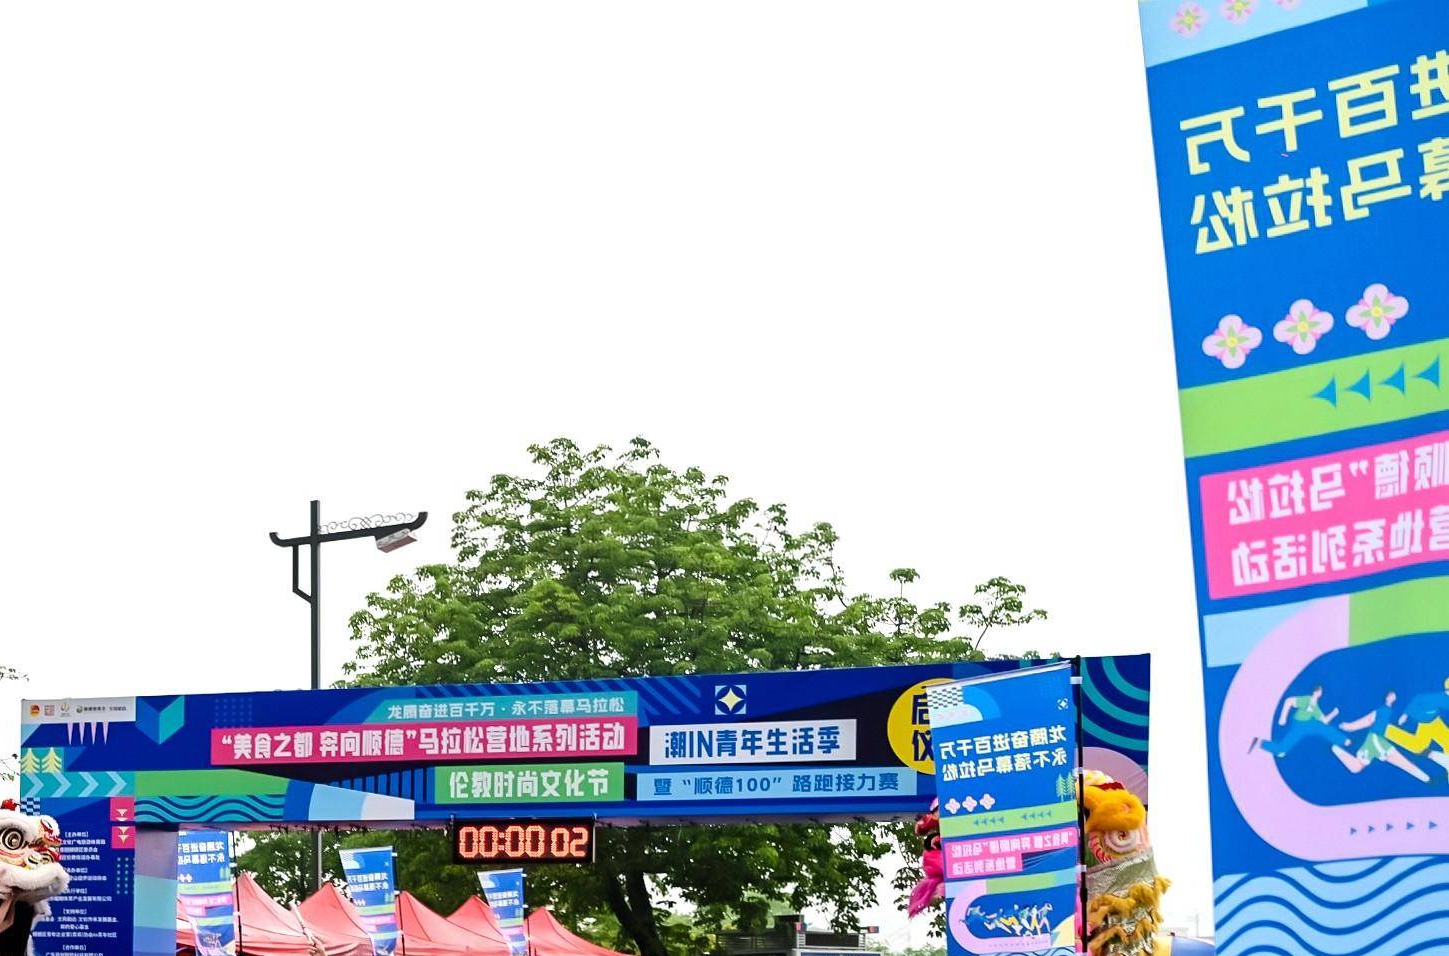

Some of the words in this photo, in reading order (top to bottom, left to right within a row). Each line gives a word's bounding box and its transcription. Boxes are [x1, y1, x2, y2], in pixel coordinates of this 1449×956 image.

[912, 692, 930, 725] 启
[665, 725, 841, 760] 潮IN青年生活季
[912, 729, 934, 762] 仪
[450, 767, 609, 799] 伦教时尚文化节
